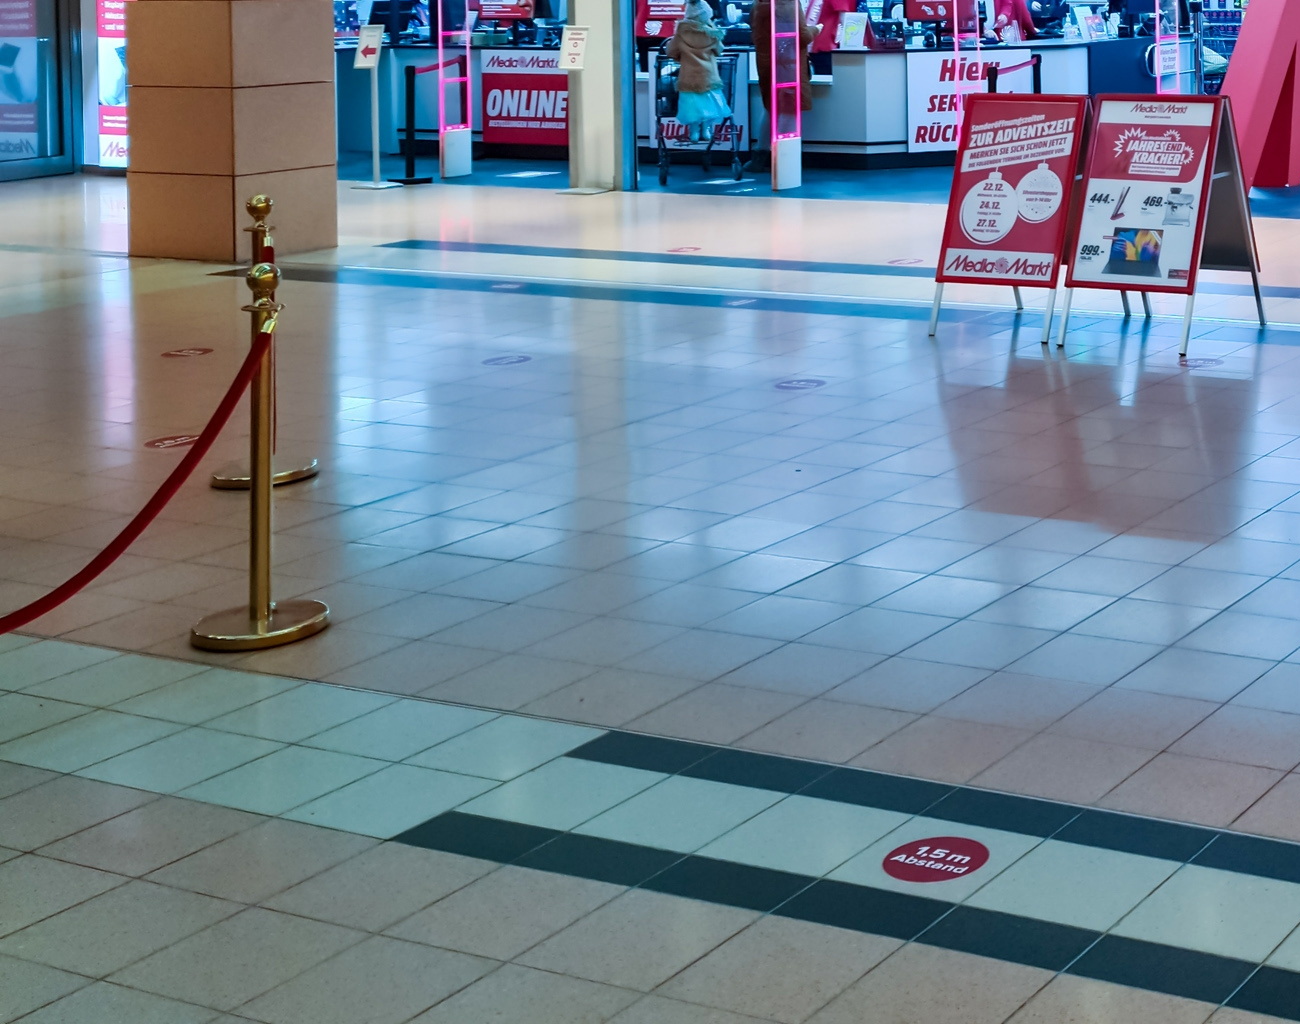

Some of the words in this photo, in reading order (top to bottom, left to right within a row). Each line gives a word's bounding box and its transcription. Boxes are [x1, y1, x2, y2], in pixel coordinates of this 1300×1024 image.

[486, 55, 519, 68] Media
[486, 88, 569, 119] ONLINE
[1130, 103, 1157, 114] Media
[1163, 104, 1188, 114] Markt
[969, 131, 995, 148] ZUR
[994, 117, 1076, 144] ADVENTSZEIT
[969, 149, 999, 160] MERKEN
[1000, 147, 1010, 155] SIE
[1010, 144, 1025, 154] SICH
[1026, 141, 1048, 151] SCHON
[1048, 137, 1068, 149] JETZT
[1131, 151, 1186, 165] KRACHER!
[1090, 193, 1115, 204] 444.-
[1143, 196, 1167, 207] 469.-
[1080, 244, 1105, 256] 999.-
[945, 254, 995, 274] Media
[1005, 257, 1051, 276] Markt
[916, 846, 950, 859] 1,5
[946, 853, 971, 864] m
[890, 854, 969, 874] Abstand
